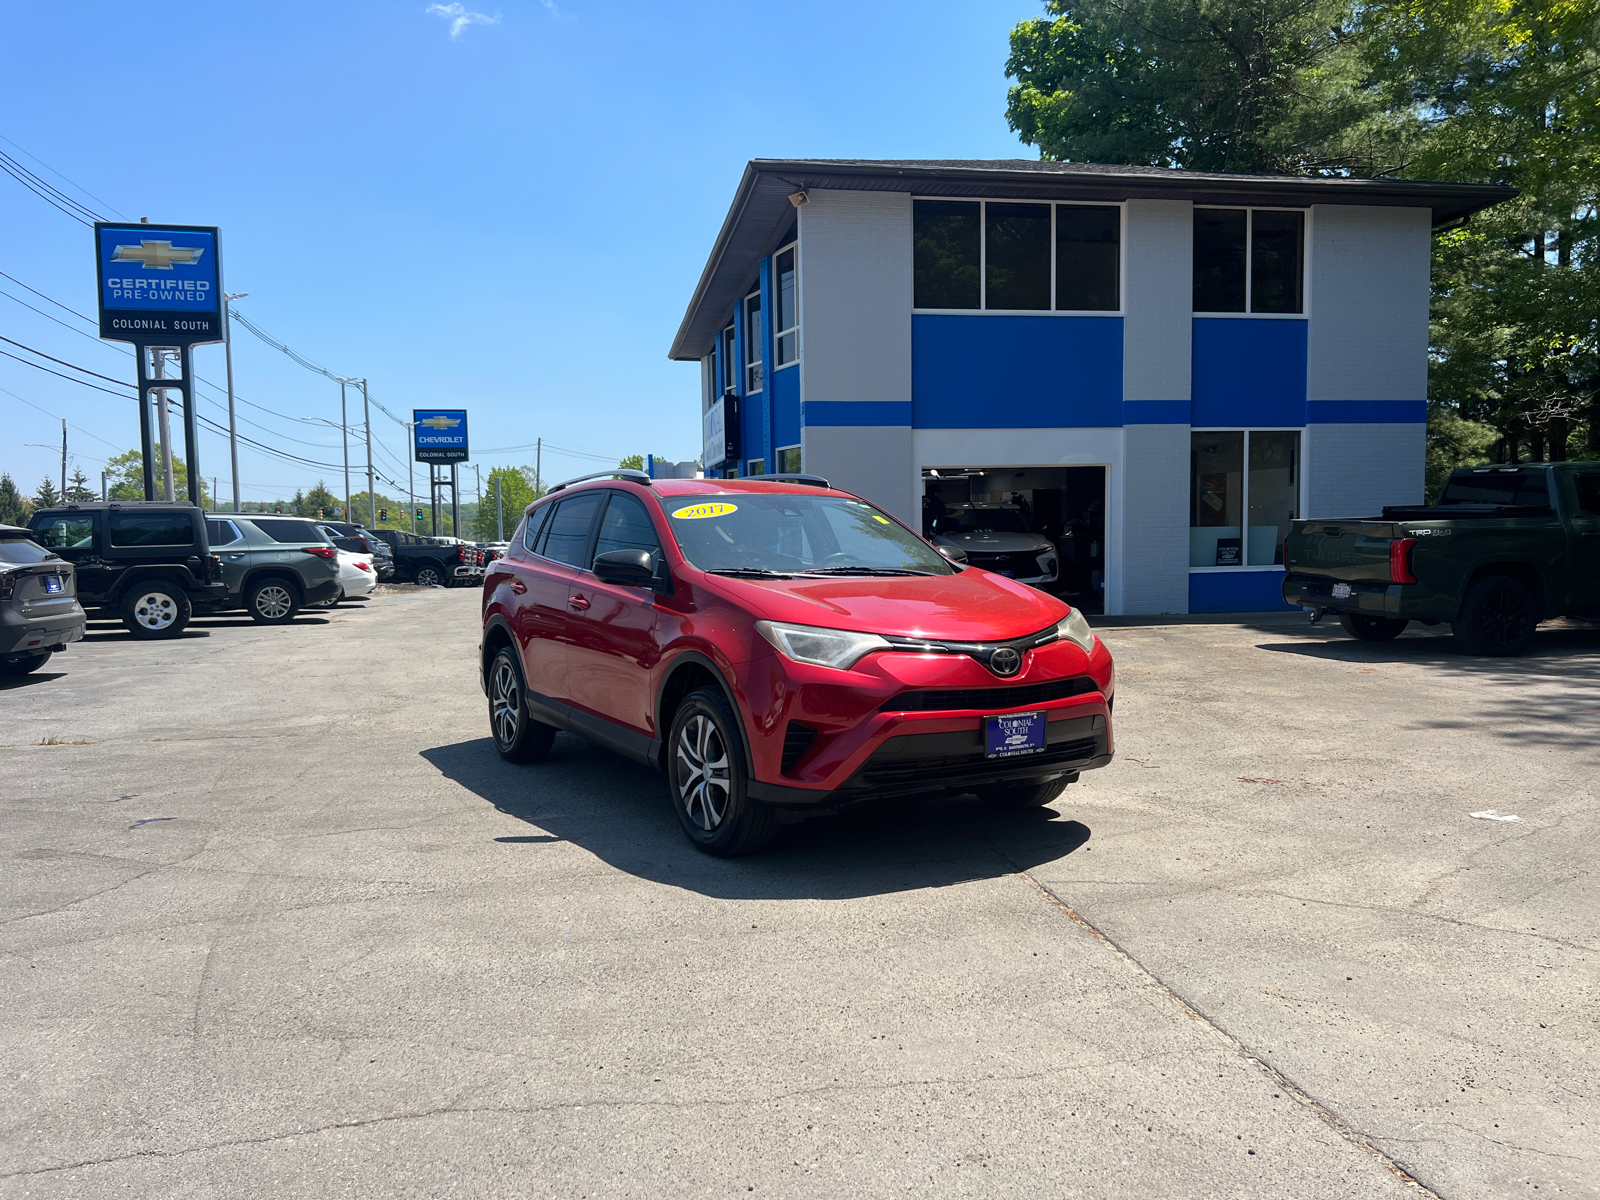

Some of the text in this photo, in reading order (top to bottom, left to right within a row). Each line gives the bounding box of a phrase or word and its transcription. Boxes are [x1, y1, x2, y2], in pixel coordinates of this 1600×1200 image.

[107, 278, 210, 291] CERTIFIED
[113, 289, 206, 301] PRE-OWNED
[112, 318, 209, 331] COLONIAL SOUTH
[685, 504, 724, 518] 2017
[1408, 528, 1432, 537] TRD
[999, 719, 1034, 729] COLONIAL
[1004, 726, 1029, 736] SOUTH
